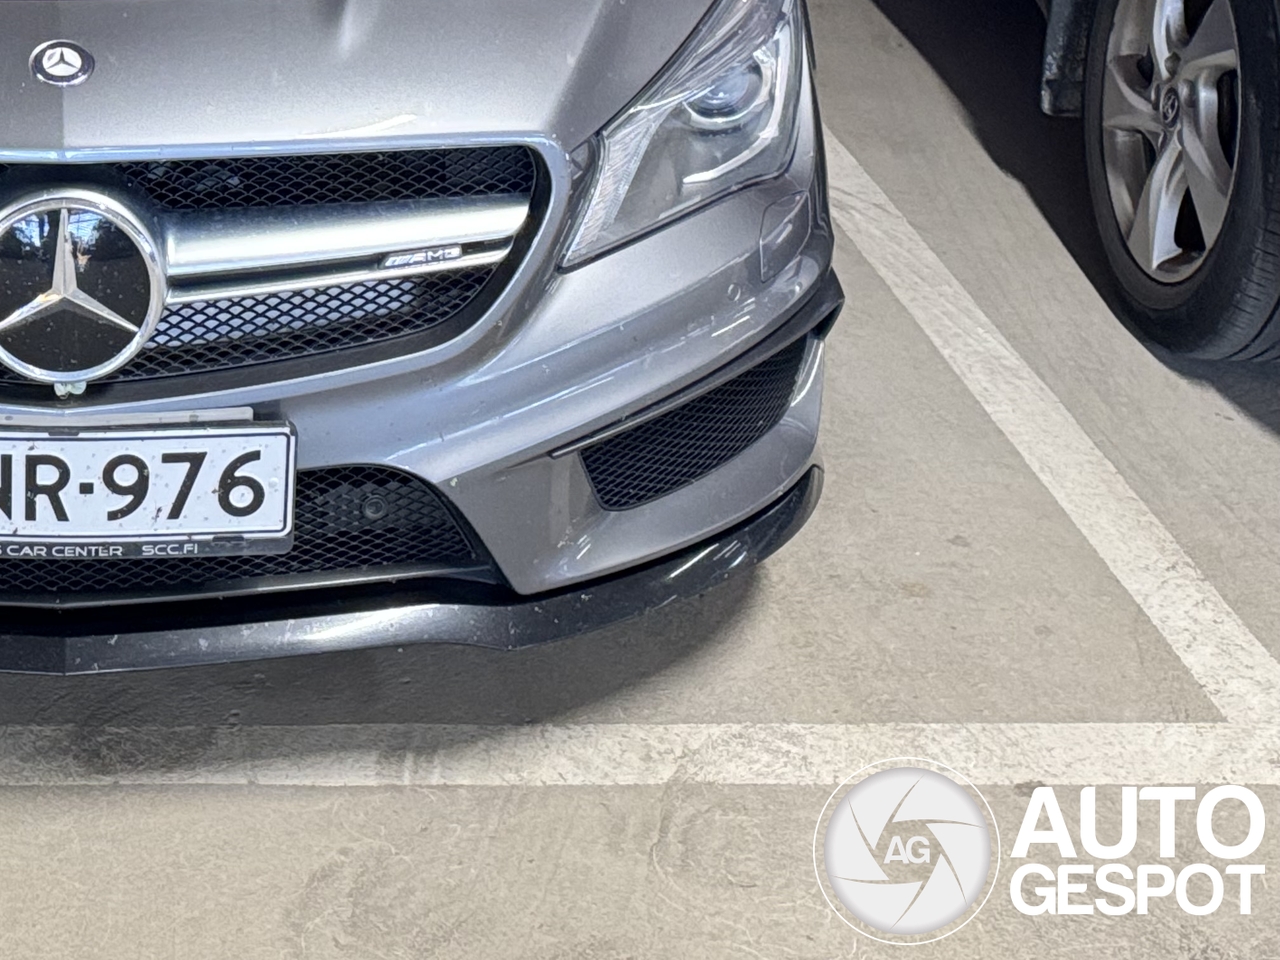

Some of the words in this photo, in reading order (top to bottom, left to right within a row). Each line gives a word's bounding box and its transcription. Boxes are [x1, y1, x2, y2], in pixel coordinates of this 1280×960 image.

[7, 544, 47, 557] CAR
[52, 545, 123, 558] CENTER
[142, 543, 199, 556] SCC.FI
